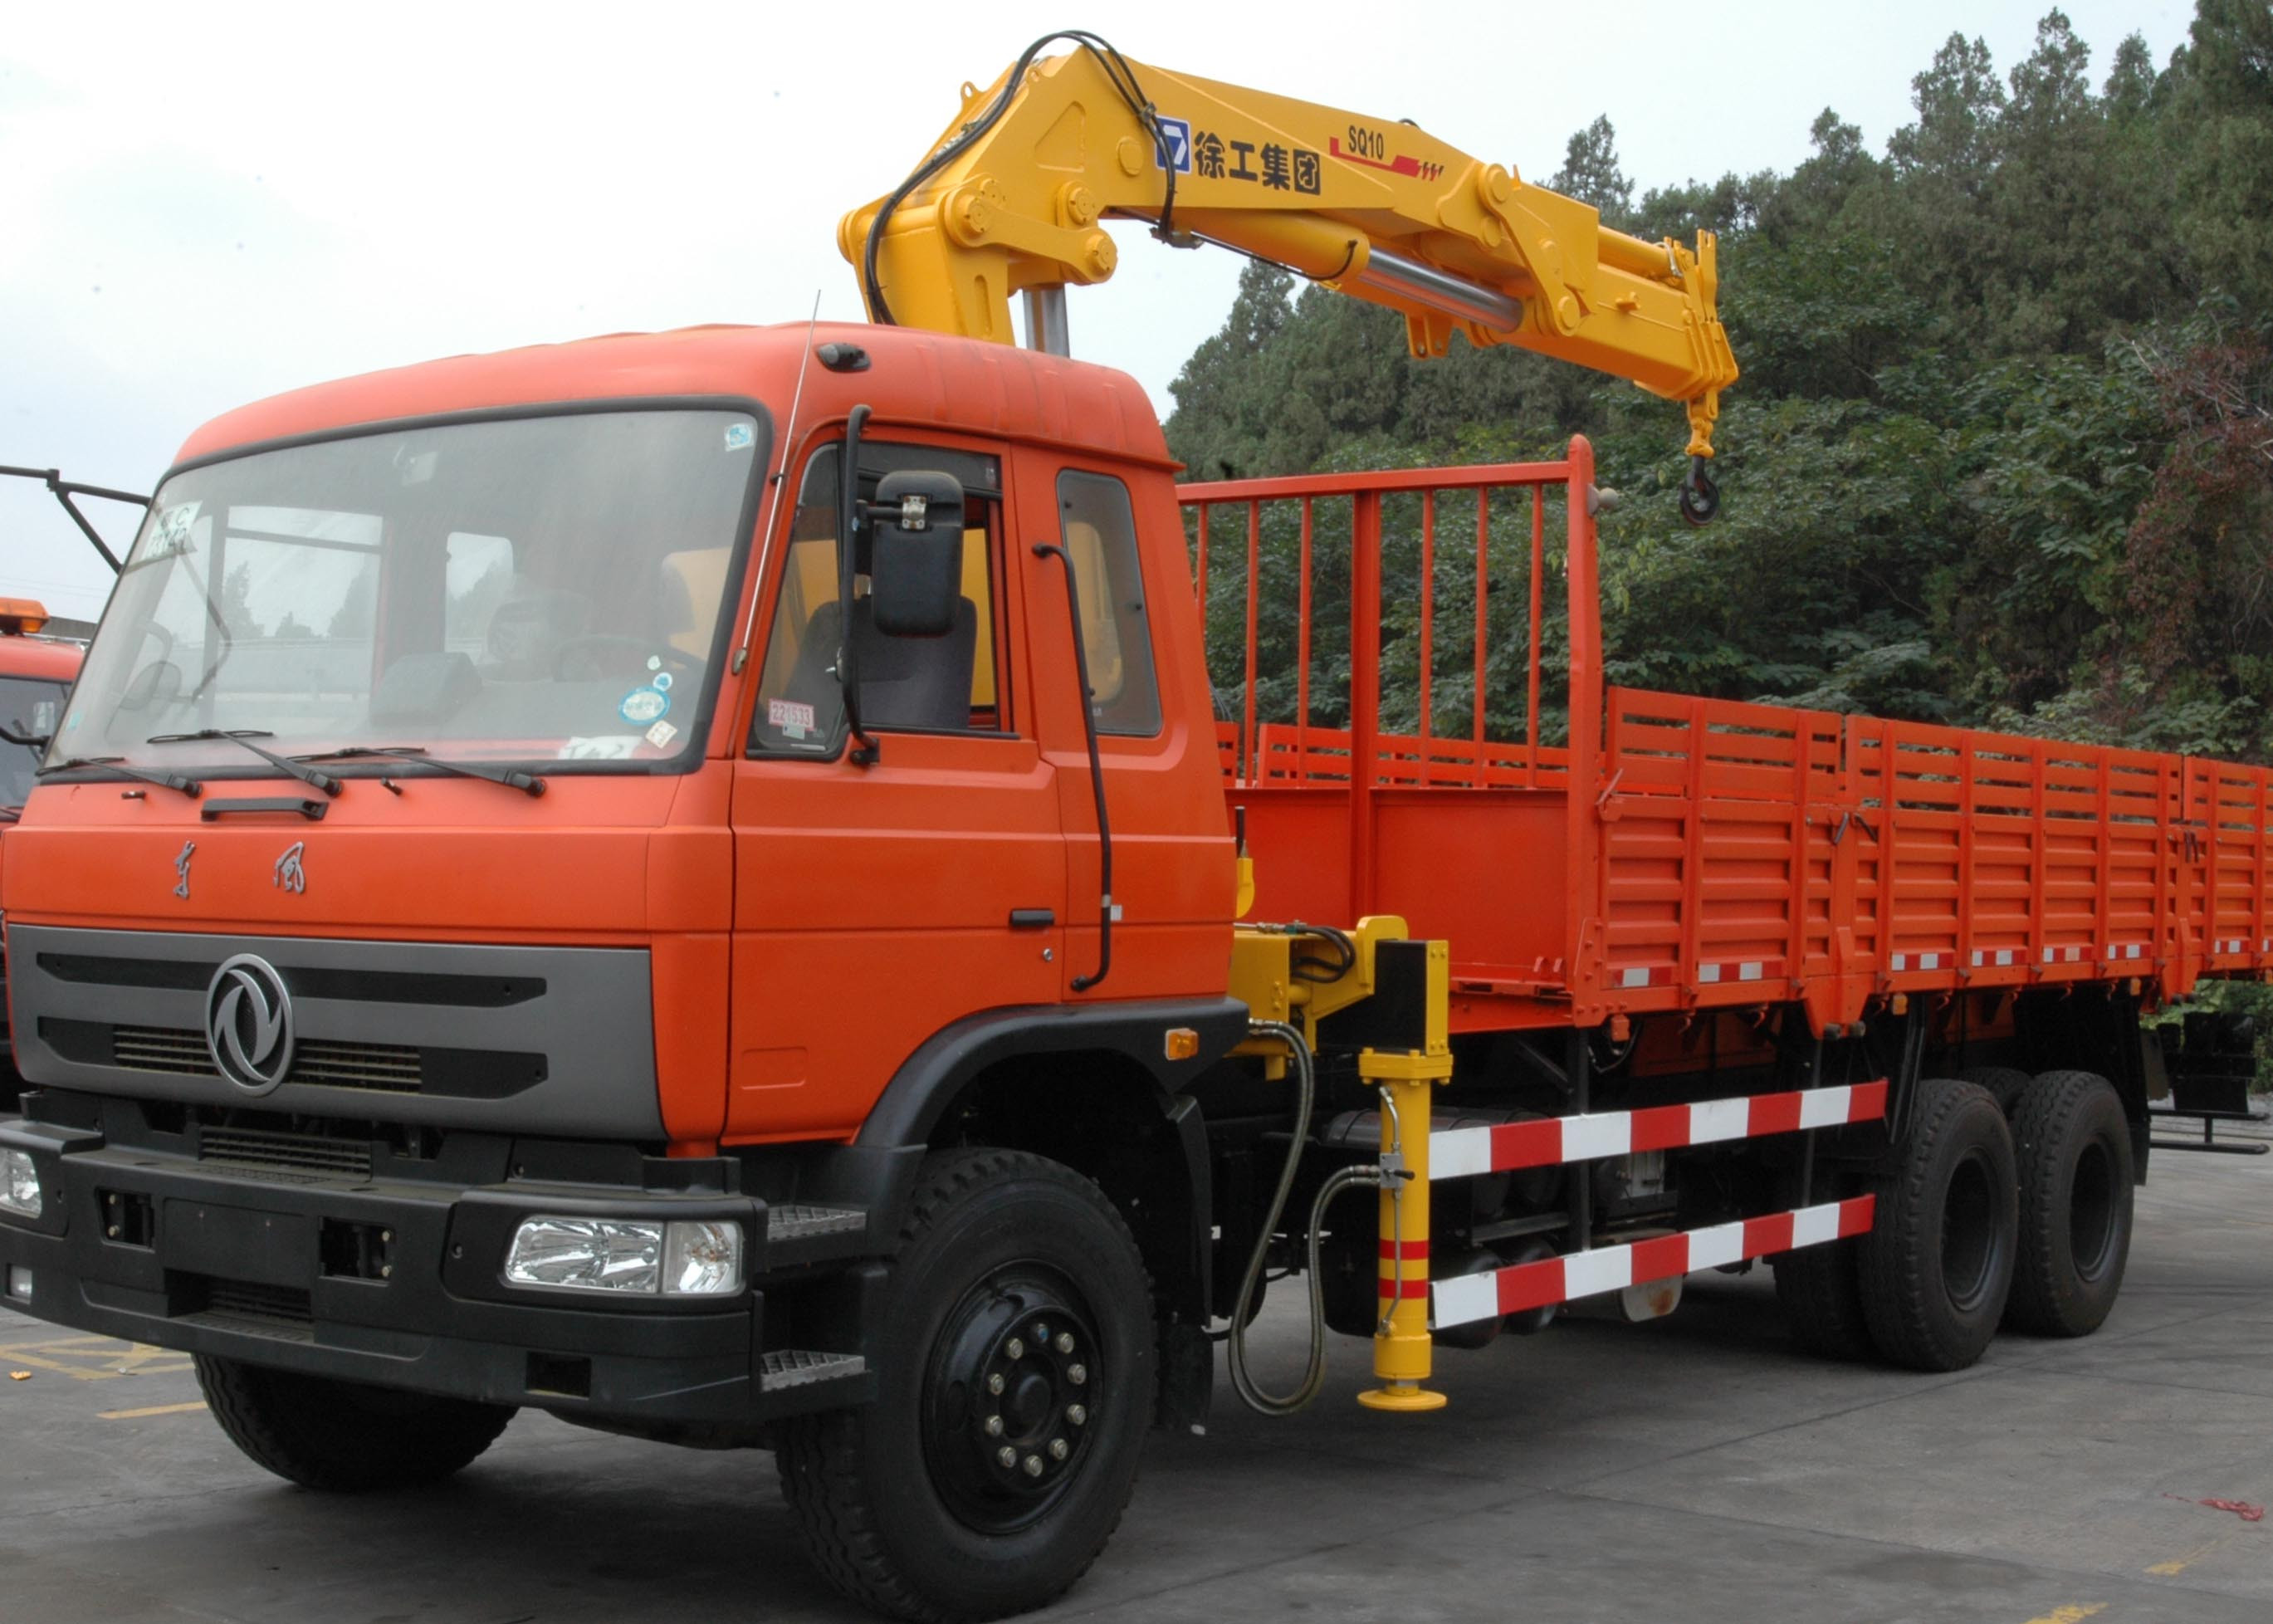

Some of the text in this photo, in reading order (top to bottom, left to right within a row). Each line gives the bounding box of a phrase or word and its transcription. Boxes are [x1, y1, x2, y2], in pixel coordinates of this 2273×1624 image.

[1194, 130, 1321, 196] 徐工集团
[1348, 125, 1385, 160] SQ10
